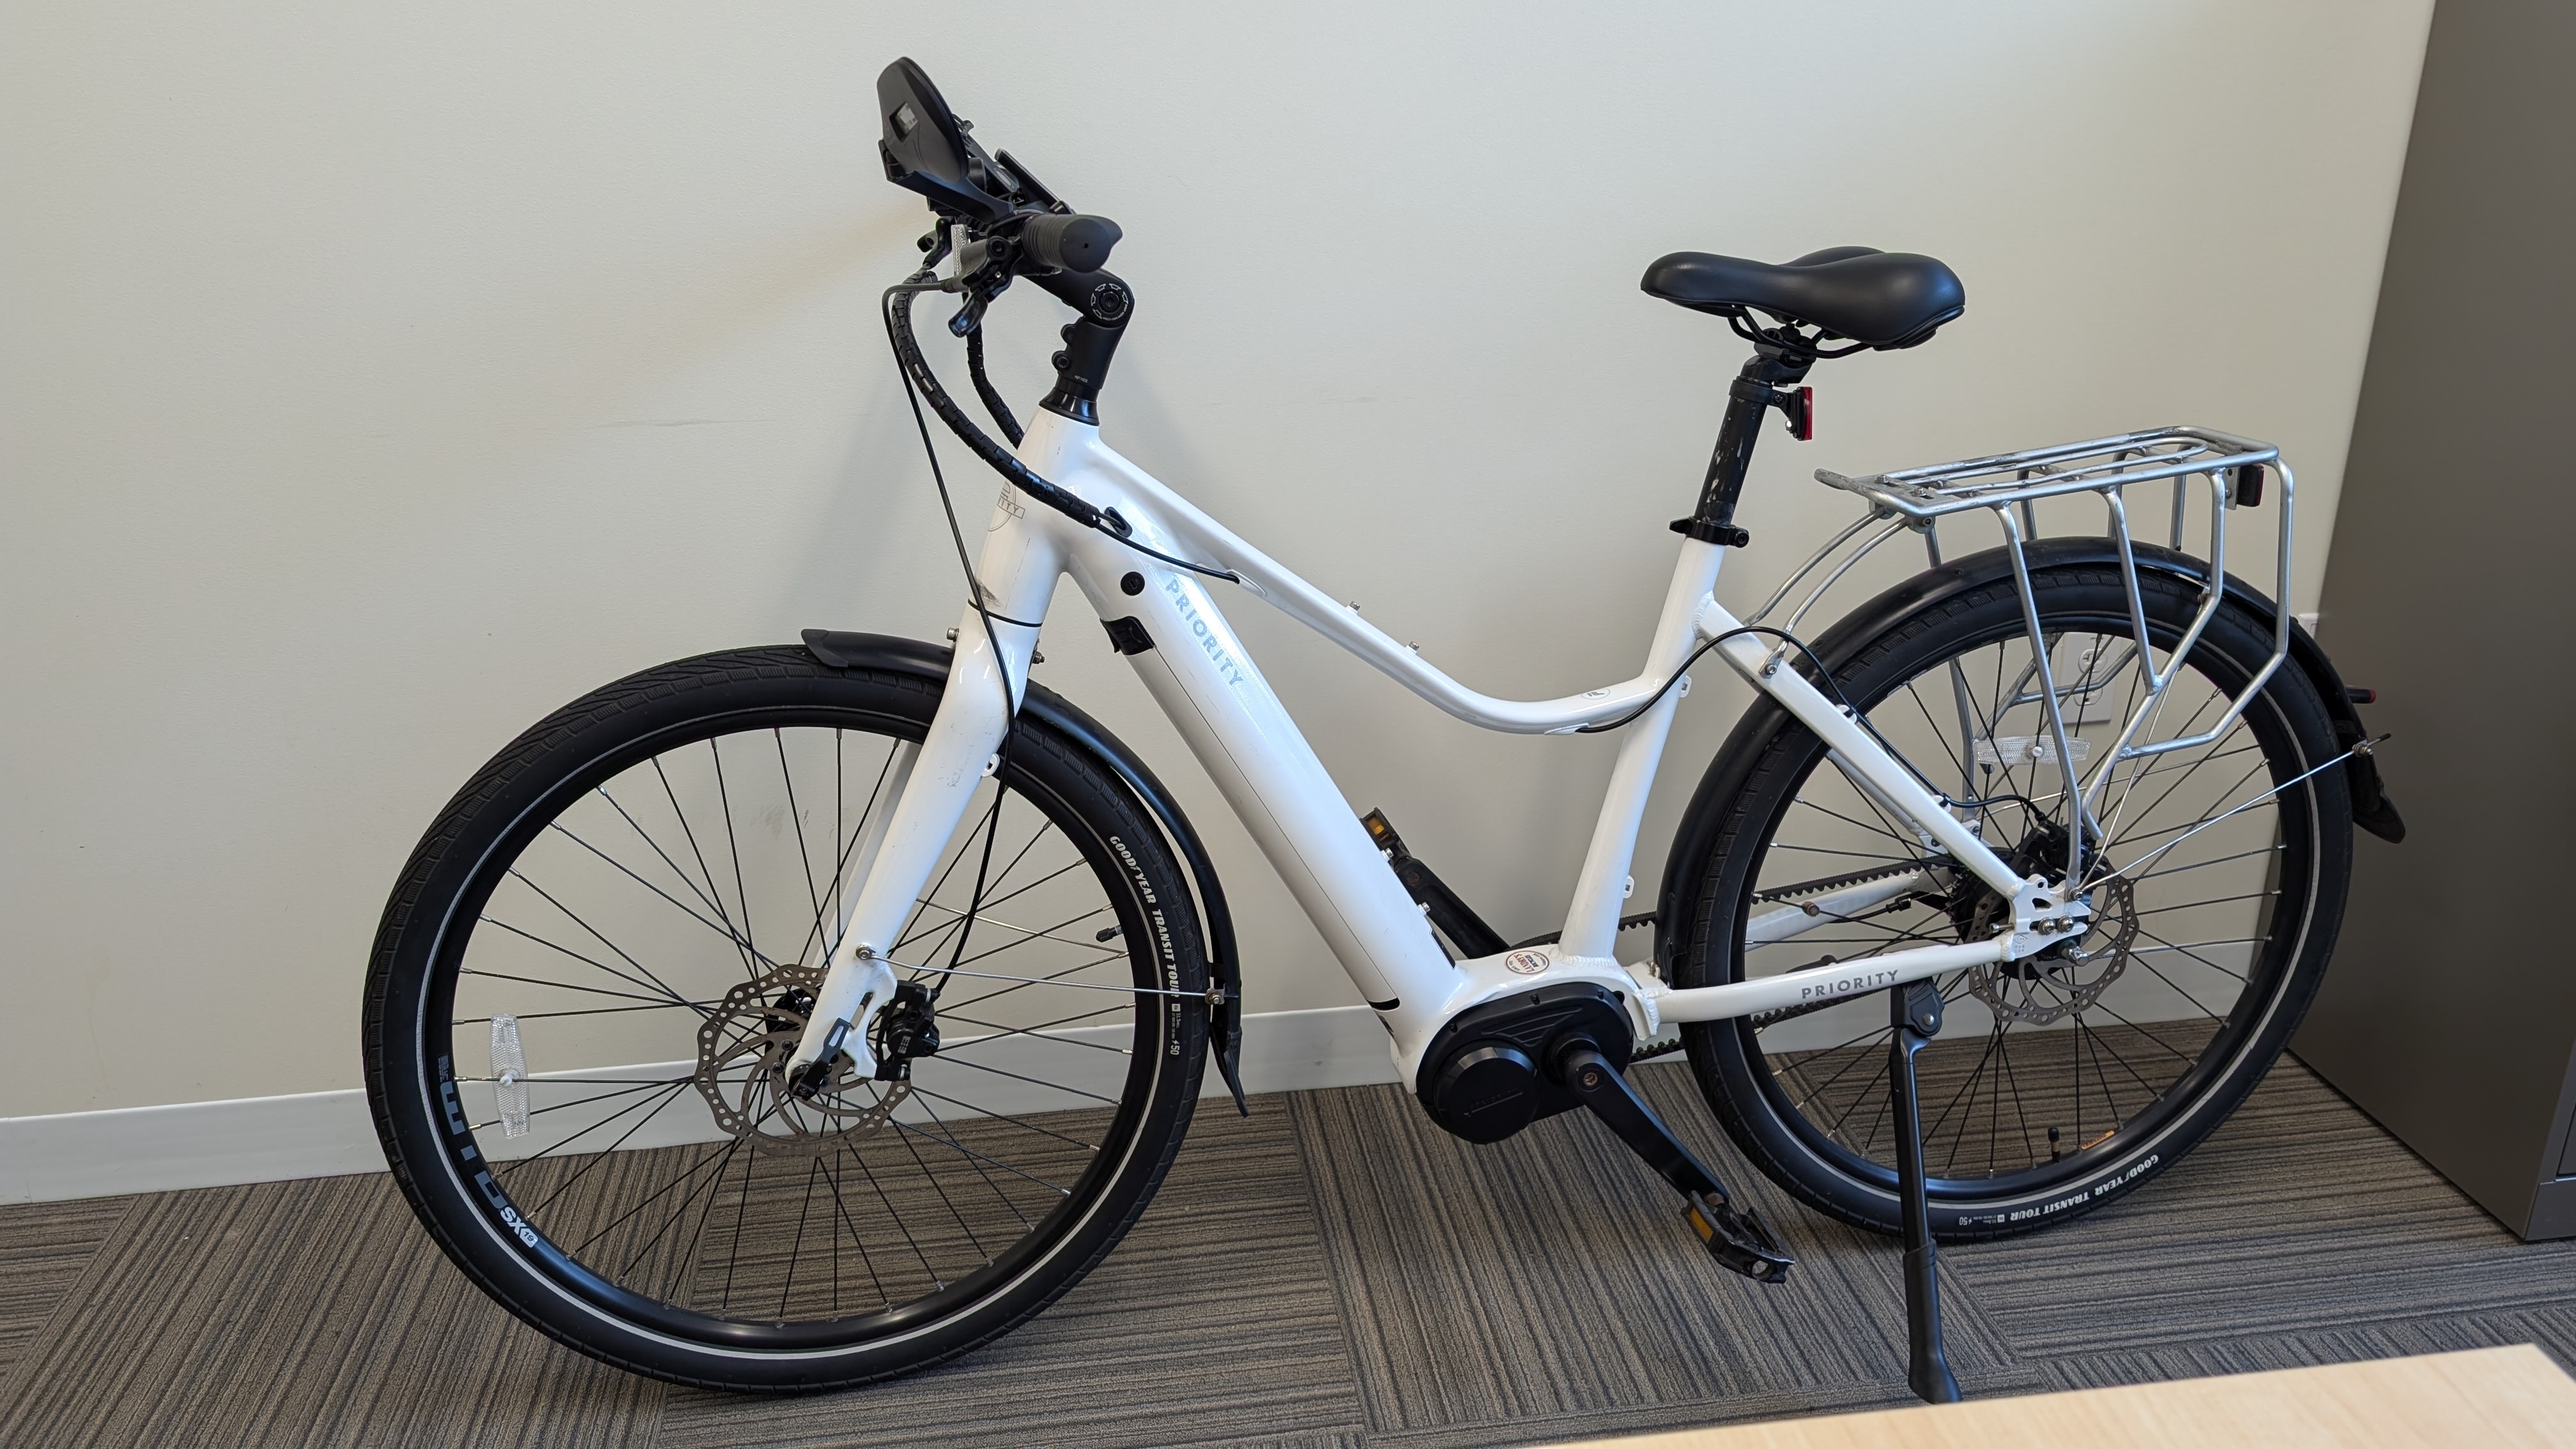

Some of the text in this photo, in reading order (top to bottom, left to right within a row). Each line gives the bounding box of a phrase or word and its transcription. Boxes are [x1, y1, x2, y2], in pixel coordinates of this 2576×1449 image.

[1165, 579, 1243, 686] PRIORITY
[1152, 909, 1175, 961] TRANSIT
[1802, 970, 1898, 999] PRIORITY
[2010, 1208, 2041, 1222] TOUR
[2043, 1192, 2090, 1215] TRANSIT
